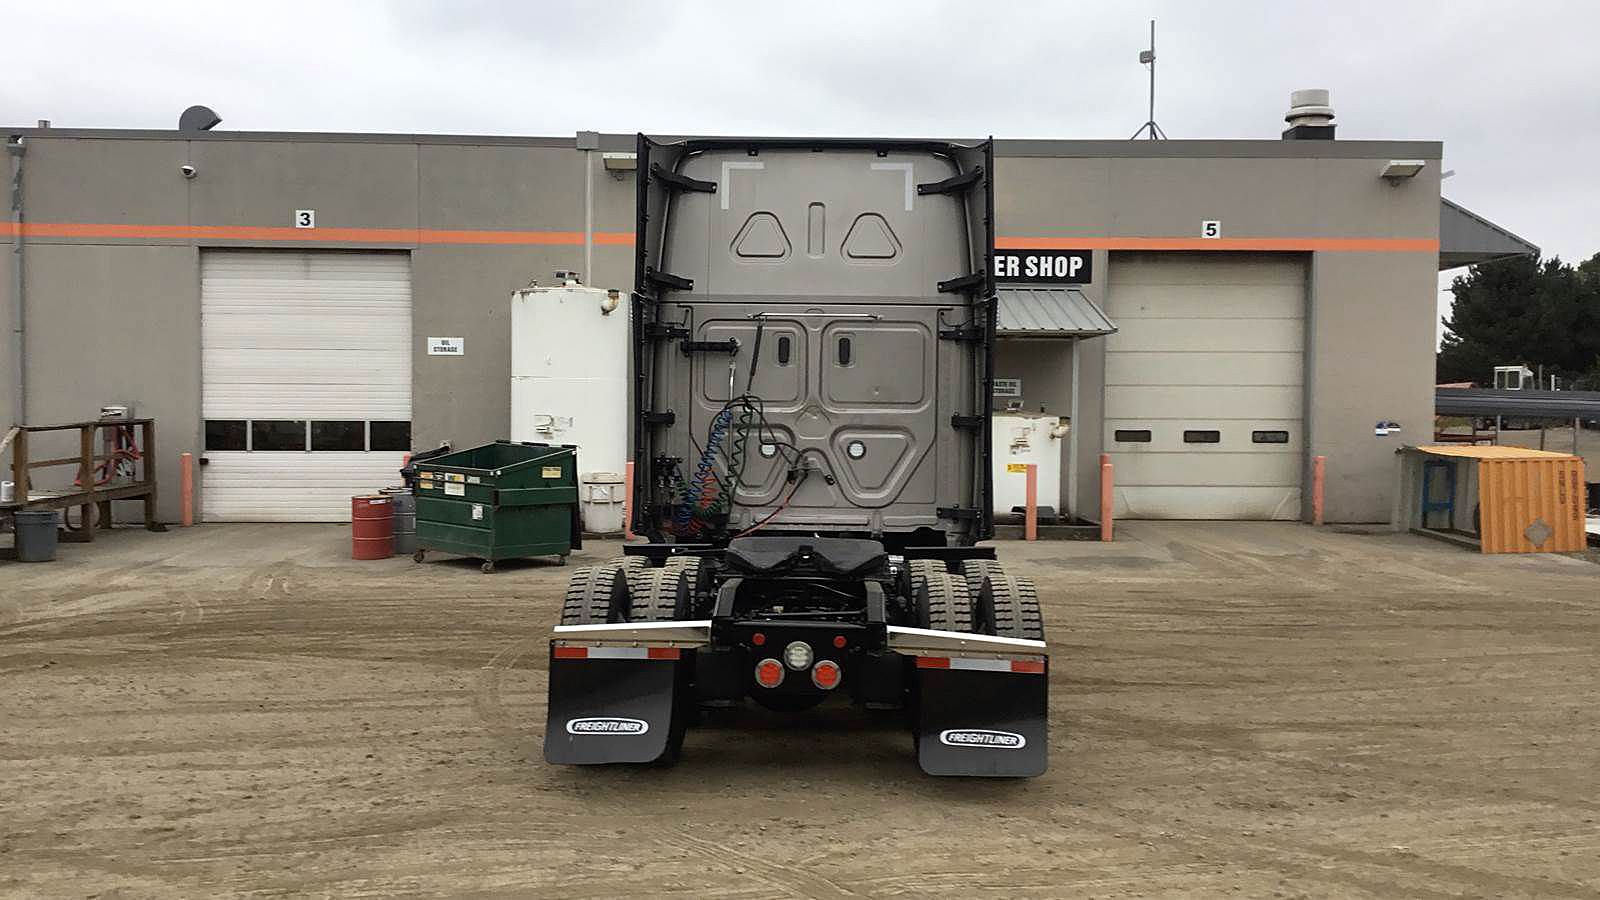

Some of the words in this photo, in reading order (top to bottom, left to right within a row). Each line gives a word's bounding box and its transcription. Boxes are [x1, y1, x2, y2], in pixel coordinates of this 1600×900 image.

[300, 212, 311, 226] 3
[1205, 222, 1217, 237] 5
[1025, 255, 1083, 277] SHOP
[574, 720, 642, 733] FREIGHTLINER
[947, 732, 1019, 746] FREIGHTLINER
